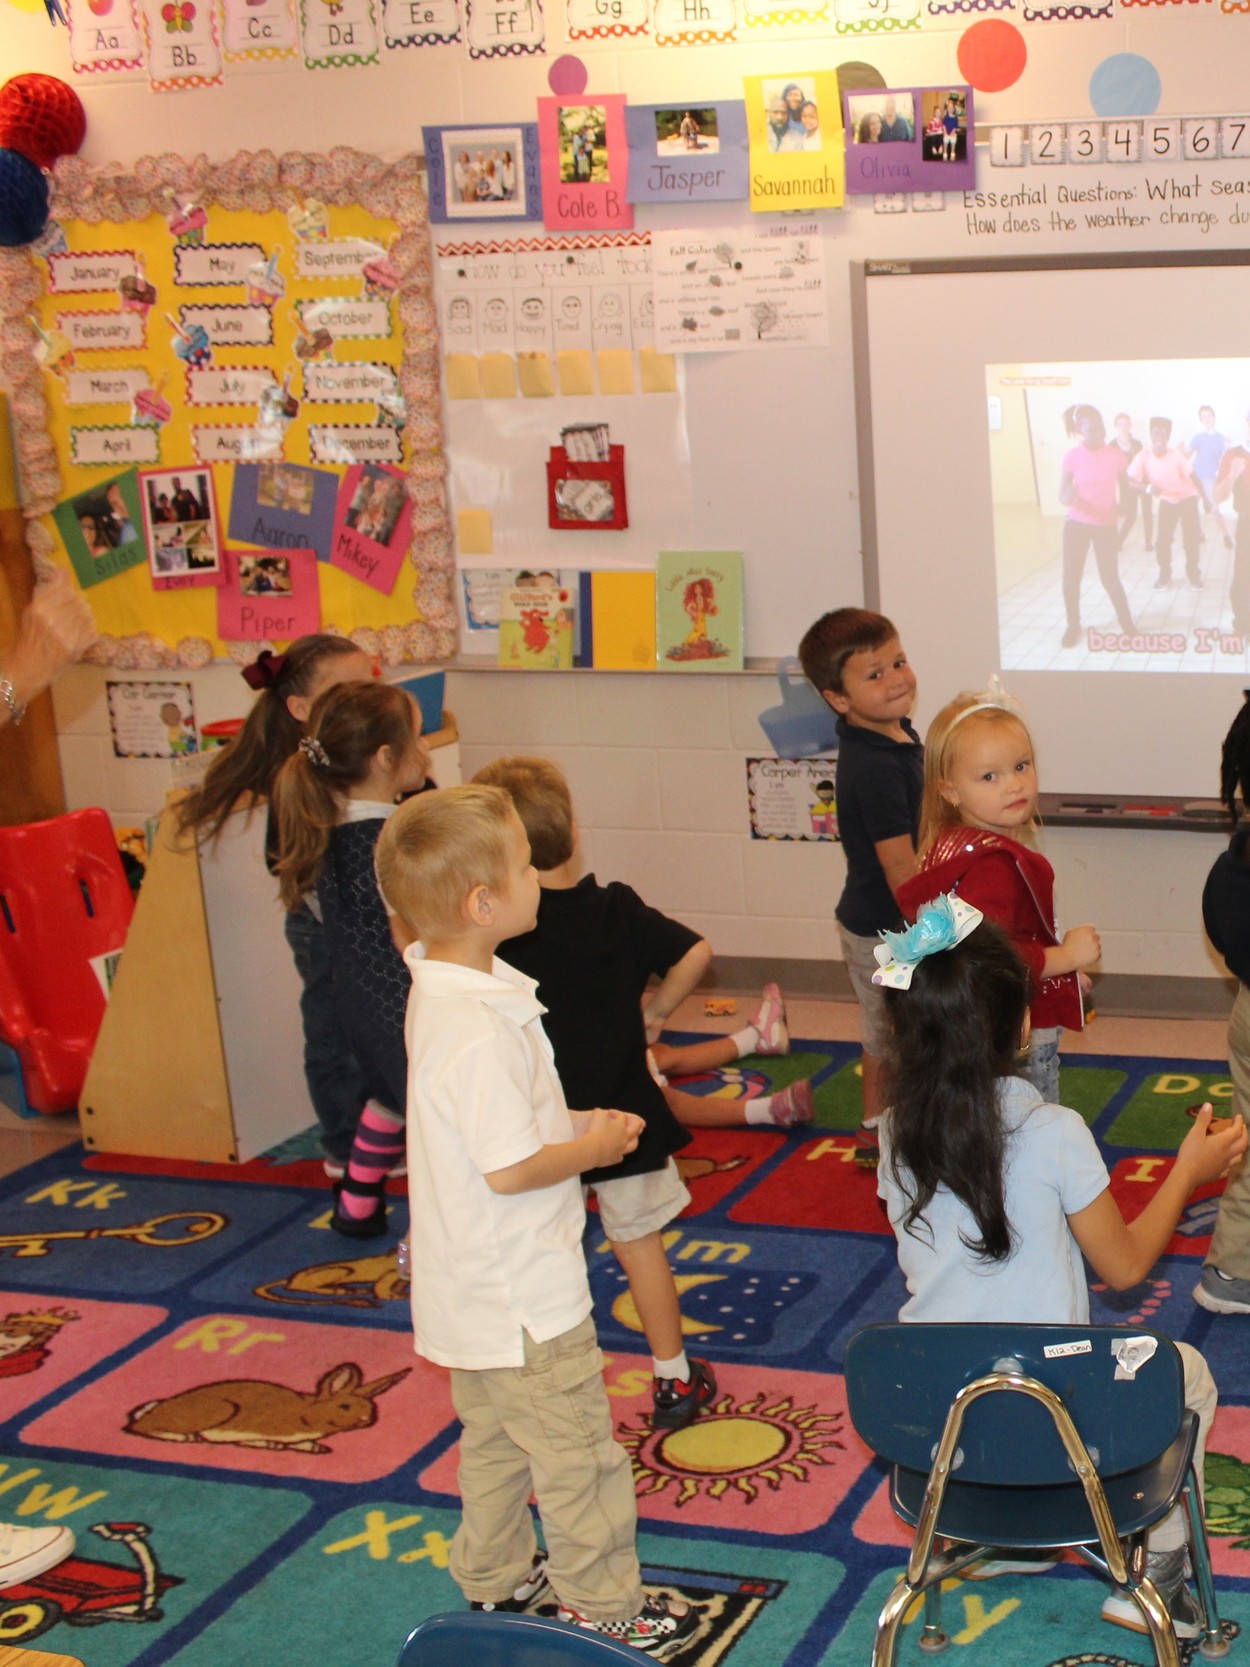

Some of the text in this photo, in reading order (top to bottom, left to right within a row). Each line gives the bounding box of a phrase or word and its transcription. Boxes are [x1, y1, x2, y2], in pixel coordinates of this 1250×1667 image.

[410, 3, 434, 23] Ee
[496, 12, 518, 34] Ff
[96, 29, 119, 49] Aa
[248, 18, 272, 38] Cc
[328, 22, 354, 46] Dd
[172, 46, 197, 67] Bb
[1004, 133, 1009, 160] 1
[1039, 131, 1055, 158] 2
[1077, 129, 1094, 156] 3
[1114, 128, 1131, 156] 4
[1153, 127, 1170, 155] 5
[1192, 126, 1210, 152] 6
[1230, 124, 1246, 151] 7
[860, 156, 911, 180] Olivia
[648, 164, 725, 197] Jasper
[753, 164, 836, 198] Savannah
[963, 183, 1047, 209] Essential
[1058, 180, 1137, 204] Questions:
[1146, 174, 1202, 200] What
[557, 193, 597, 218] Cole
[966, 212, 996, 235] How
[1003, 211, 1040, 234] does
[1048, 210, 1077, 231] the
[1084, 207, 1150, 229] weather
[1160, 204, 1219, 233] change
[70, 266, 120, 281] January
[209, 258, 236, 274] May
[211, 318, 244, 332] June
[318, 311, 373, 325] October
[73, 323, 131, 341] February
[90, 379, 128, 393] March
[103, 437, 132, 454] April
[241, 608, 296, 635] Piper
[1087, 630, 1187, 655] because
[1195, 631, 1244, 656] I'm
[25, 1178, 127, 1210] Kk
[173, 1317, 286, 1356] Rr
